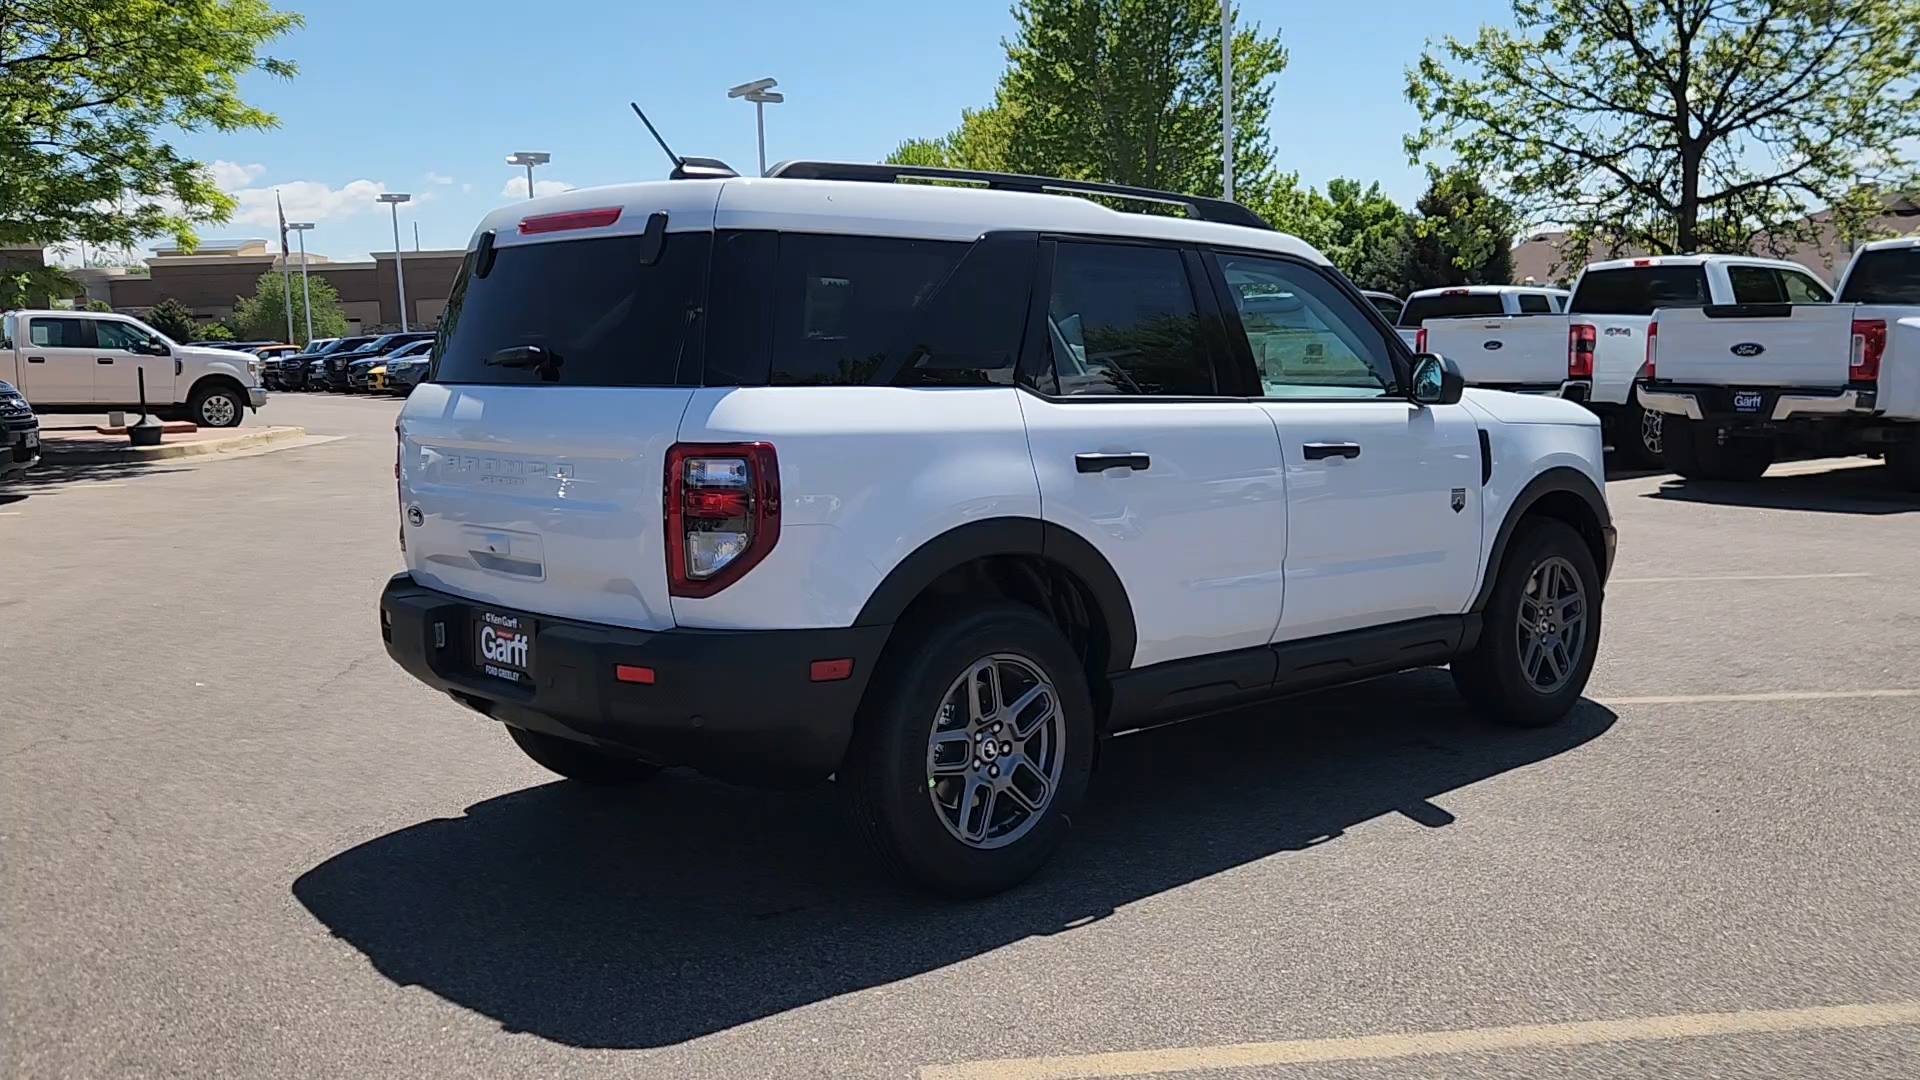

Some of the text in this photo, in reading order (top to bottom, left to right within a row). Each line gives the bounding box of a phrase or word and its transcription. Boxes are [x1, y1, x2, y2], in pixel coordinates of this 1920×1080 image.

[1734, 395, 1762, 407] Garff
[502, 616, 517, 628] Garff
[481, 626, 528, 667] Garff
[485, 665, 519, 682] FORD GREELEY
